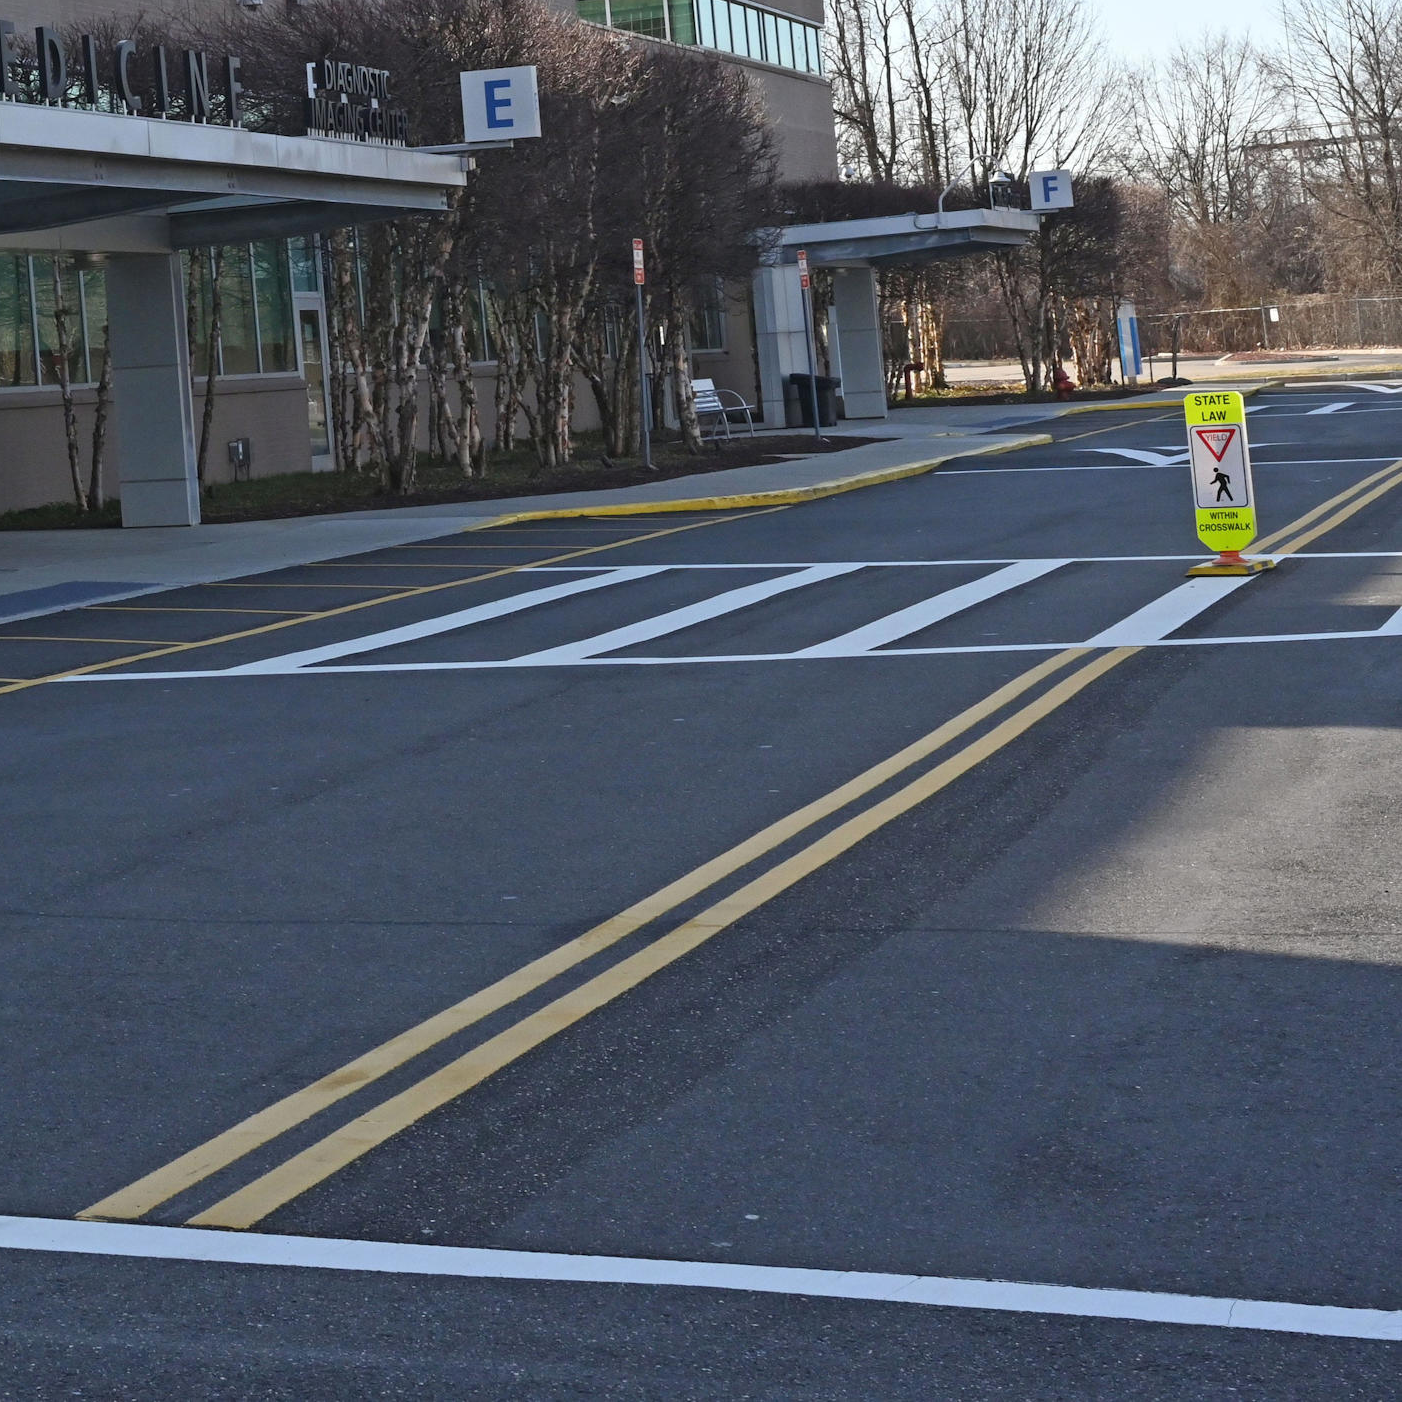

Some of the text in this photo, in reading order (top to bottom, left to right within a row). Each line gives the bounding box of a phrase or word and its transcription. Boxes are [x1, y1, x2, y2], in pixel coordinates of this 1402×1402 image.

[323, 59, 392, 100] DIAGNOSTIC
[484, 79, 514, 129] E
[311, 97, 409, 139] IMAGING CENTER
[1042, 175, 1058, 203] F
[1194, 394, 1231, 406] STATE
[1201, 410, 1227, 422] LAW
[1204, 433, 1228, 442] YIELD
[1209, 511, 1239, 520] WITHIN
[1199, 522, 1252, 532] CROSSWALK
